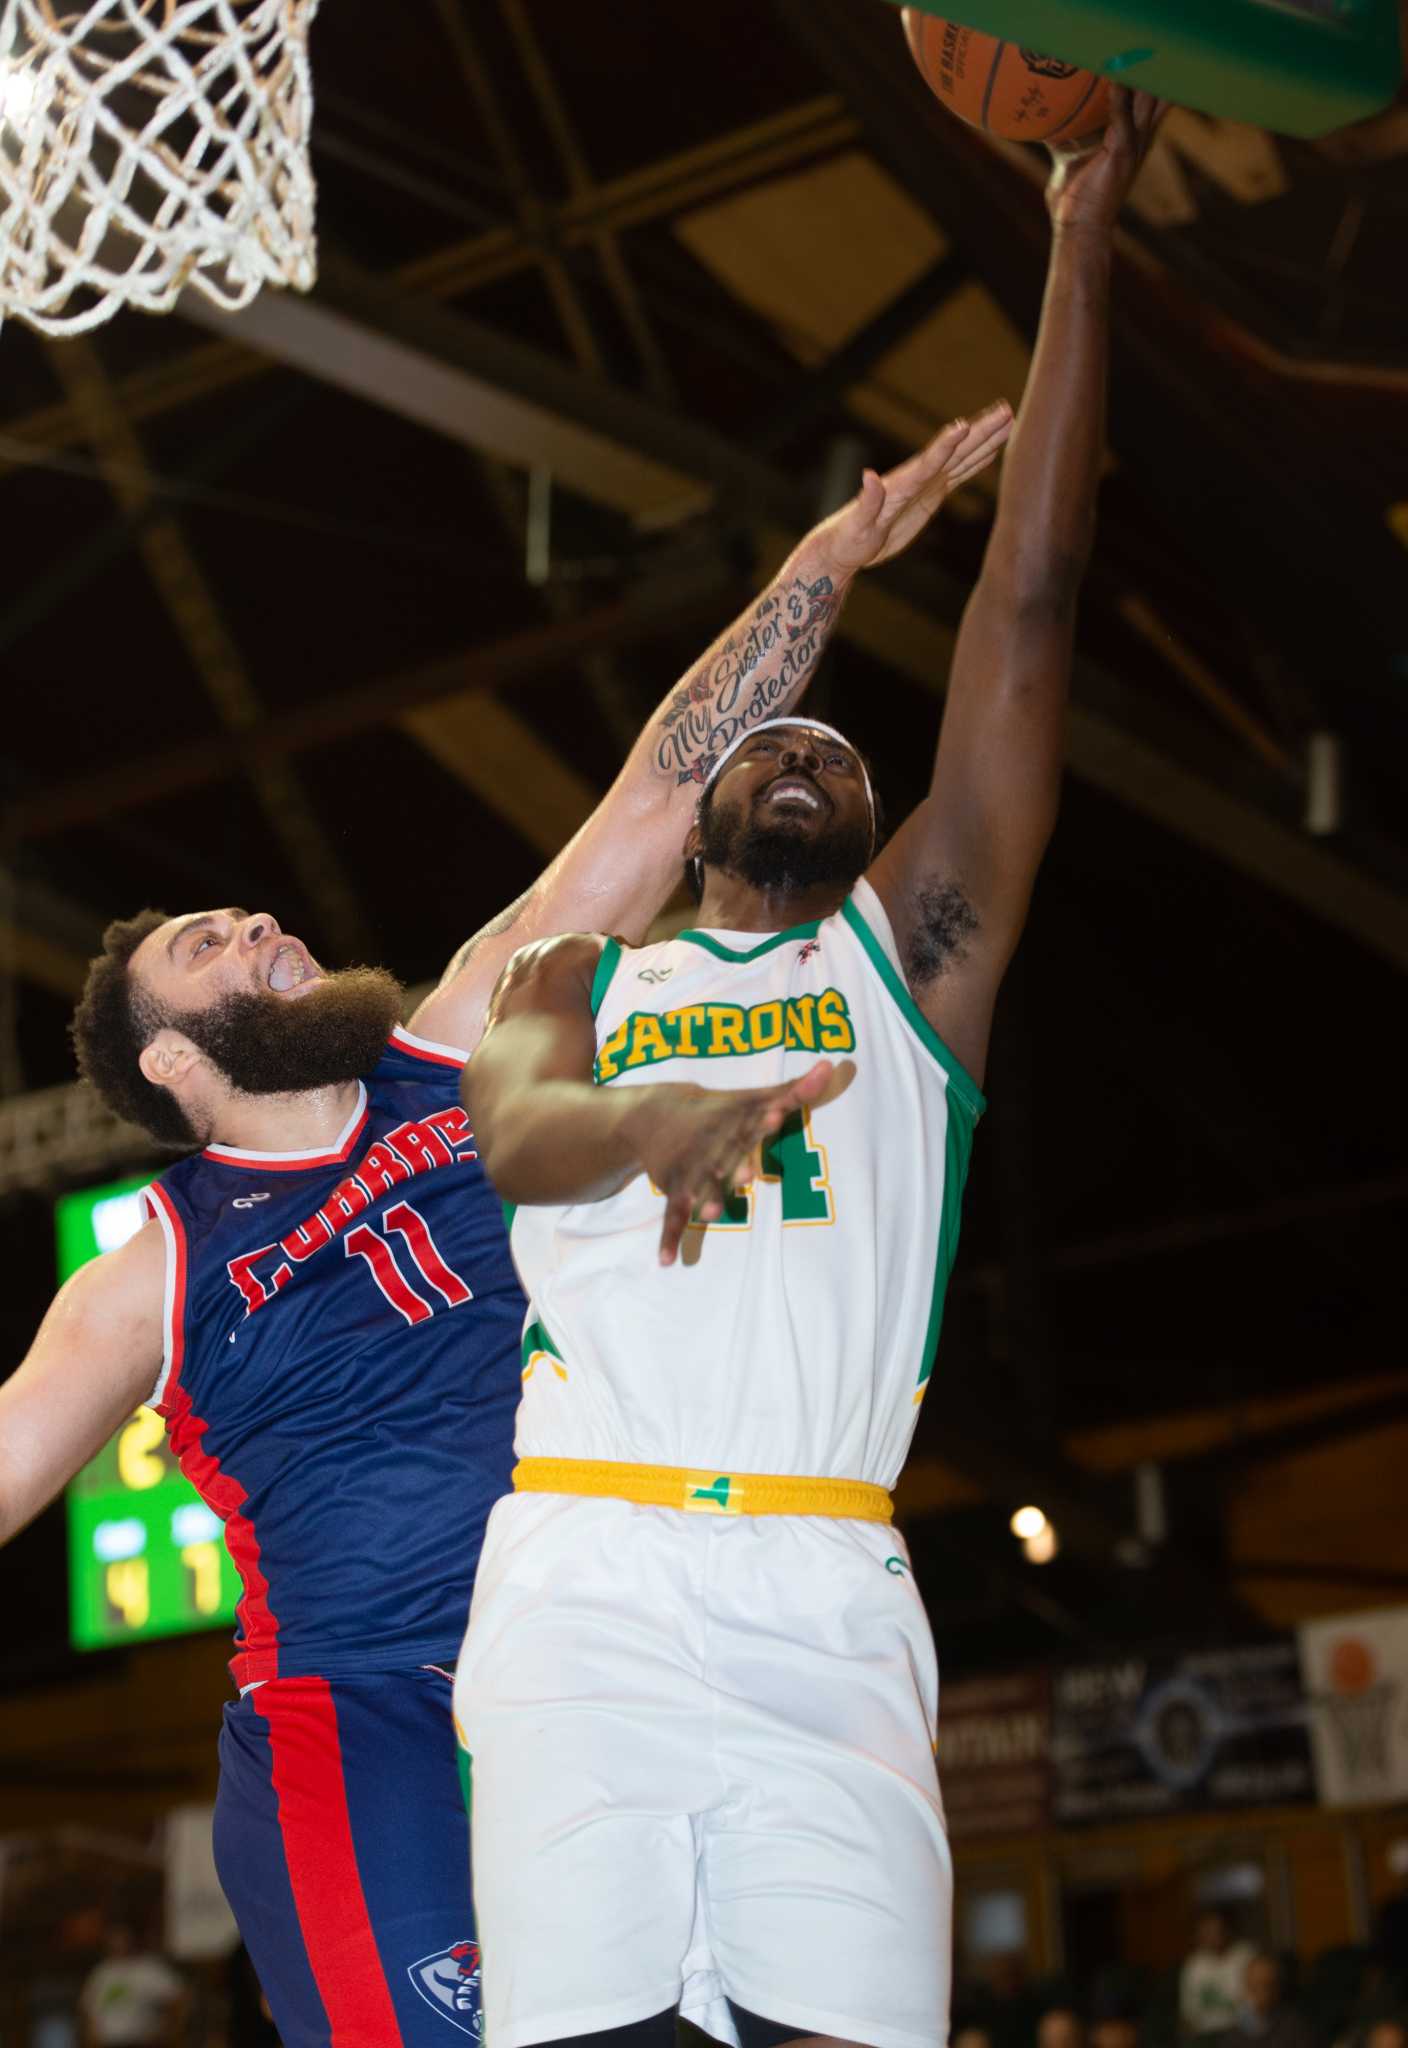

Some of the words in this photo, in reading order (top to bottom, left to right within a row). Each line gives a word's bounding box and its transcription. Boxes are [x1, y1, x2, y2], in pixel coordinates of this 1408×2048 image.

[657, 704, 712, 771] My
[707, 627, 821, 753] Protector
[594, 987, 857, 1085] PATRONS
[344, 1200, 475, 1326] 11
